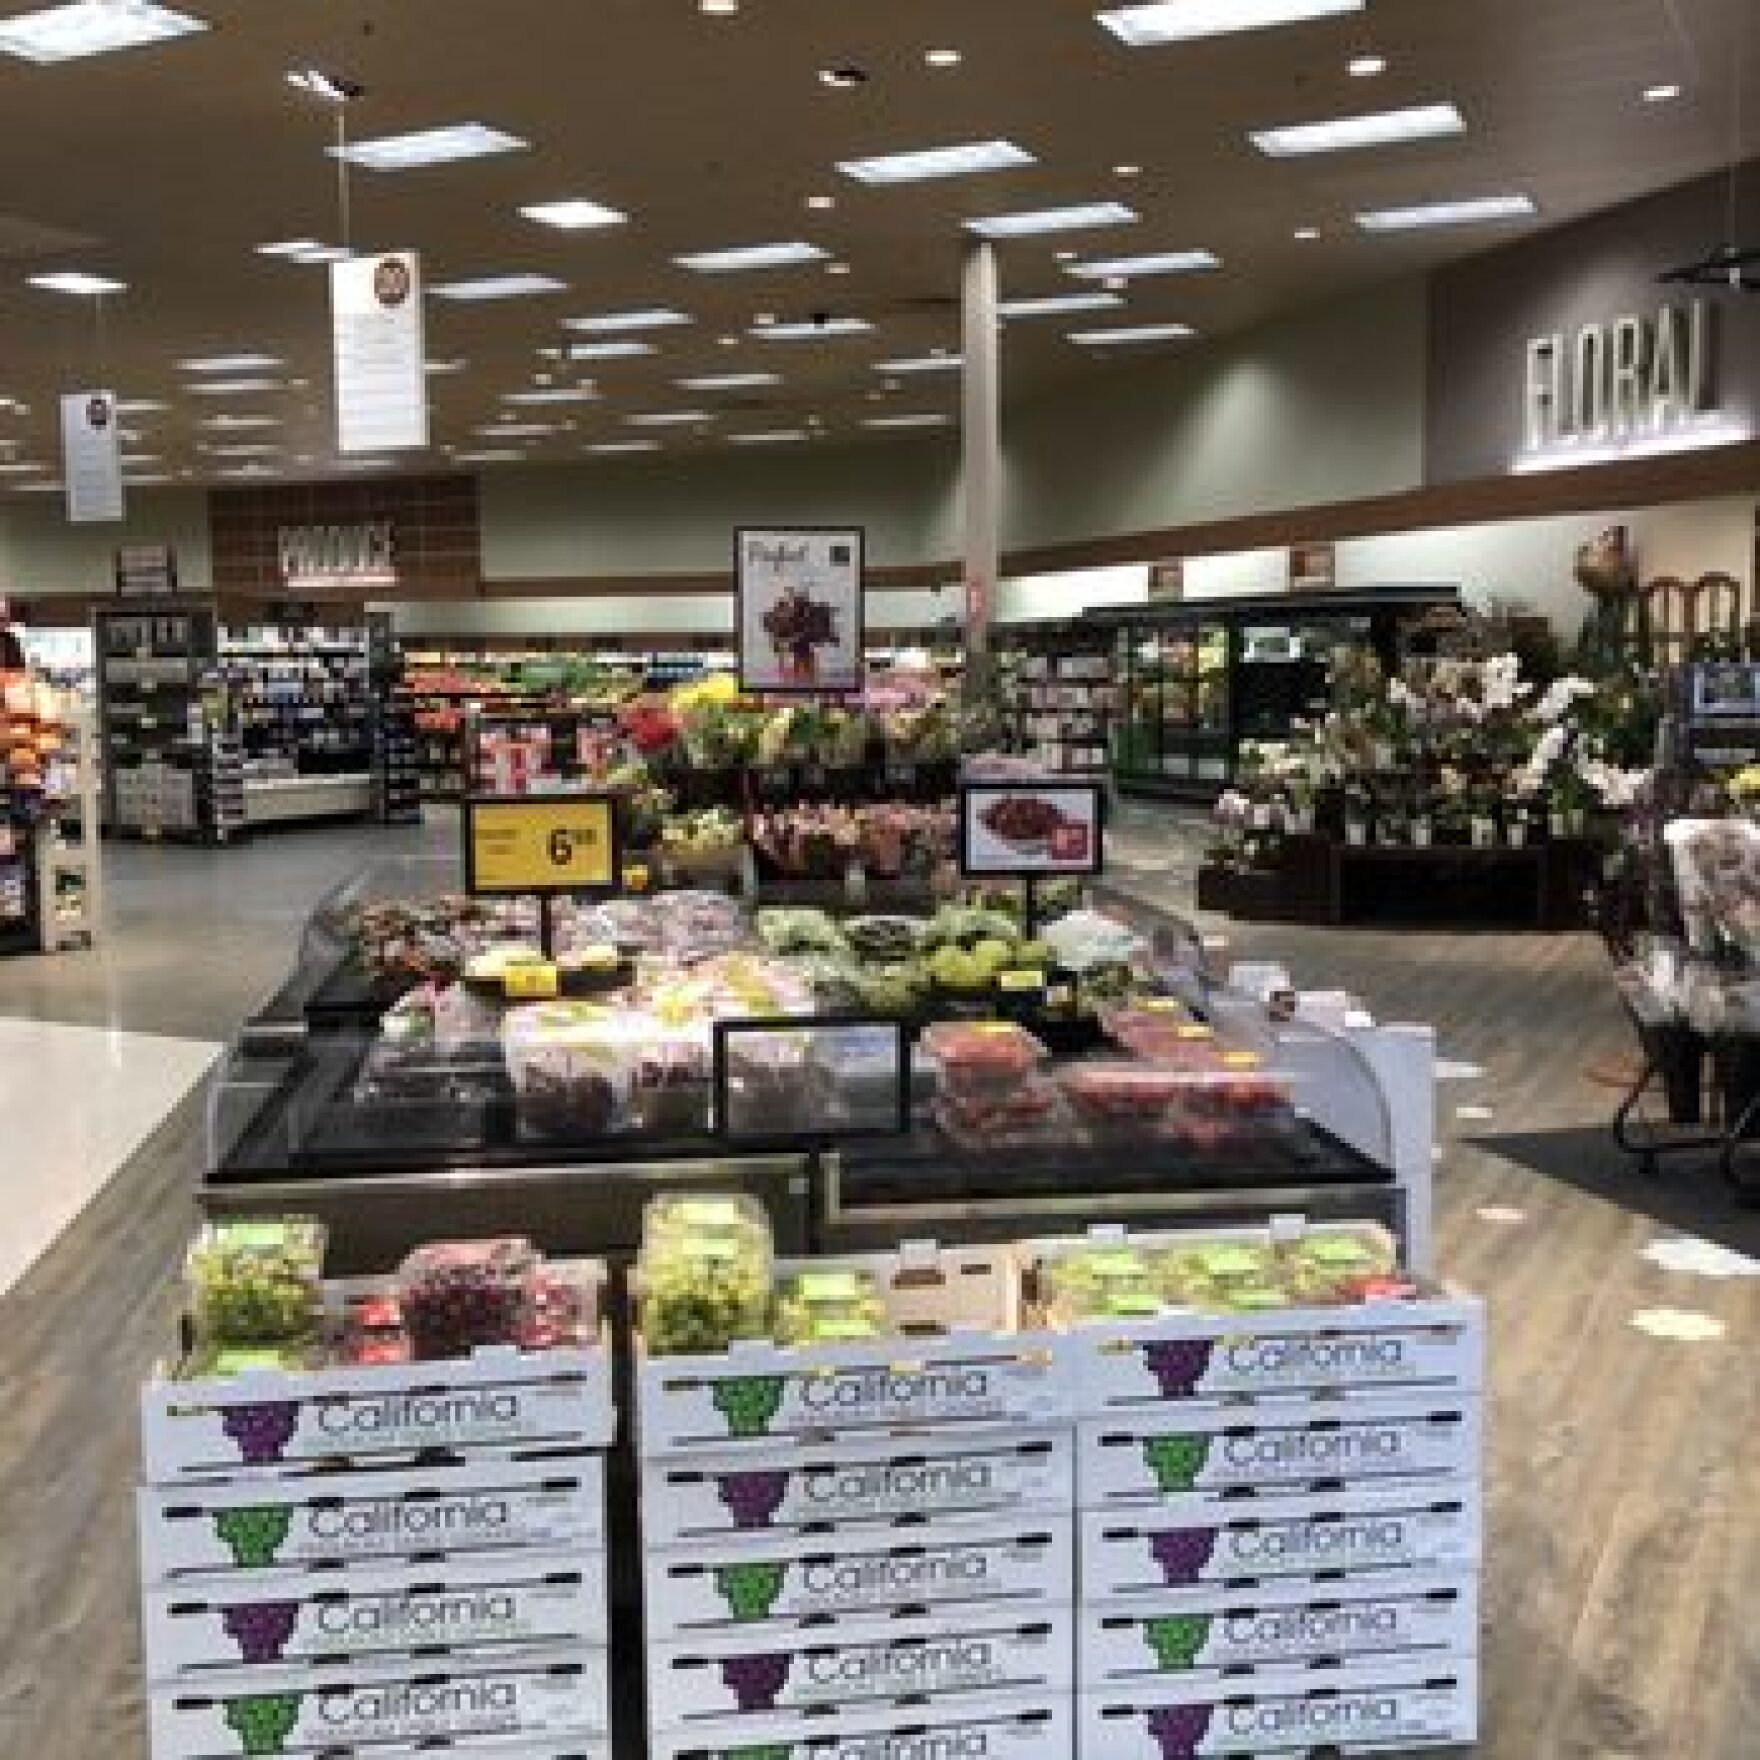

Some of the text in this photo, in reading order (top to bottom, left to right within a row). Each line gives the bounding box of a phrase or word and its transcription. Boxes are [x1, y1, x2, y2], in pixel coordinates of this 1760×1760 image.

[1525, 298, 1724, 448] FLORAL
[1229, 1338, 1400, 1371] California
[804, 1370, 986, 1410] California
[318, 1390, 517, 1432] California
[1224, 1430, 1396, 1467] California
[804, 1461, 991, 1502] California
[308, 1497, 506, 1538] California
[1231, 1521, 1400, 1559] California
[804, 1552, 986, 1593] California
[318, 1595, 513, 1633] California
[1224, 1606, 1396, 1643] California
[809, 1643, 991, 1685] California
[318, 1682, 517, 1723] California
[1229, 1697, 1396, 1735] California
